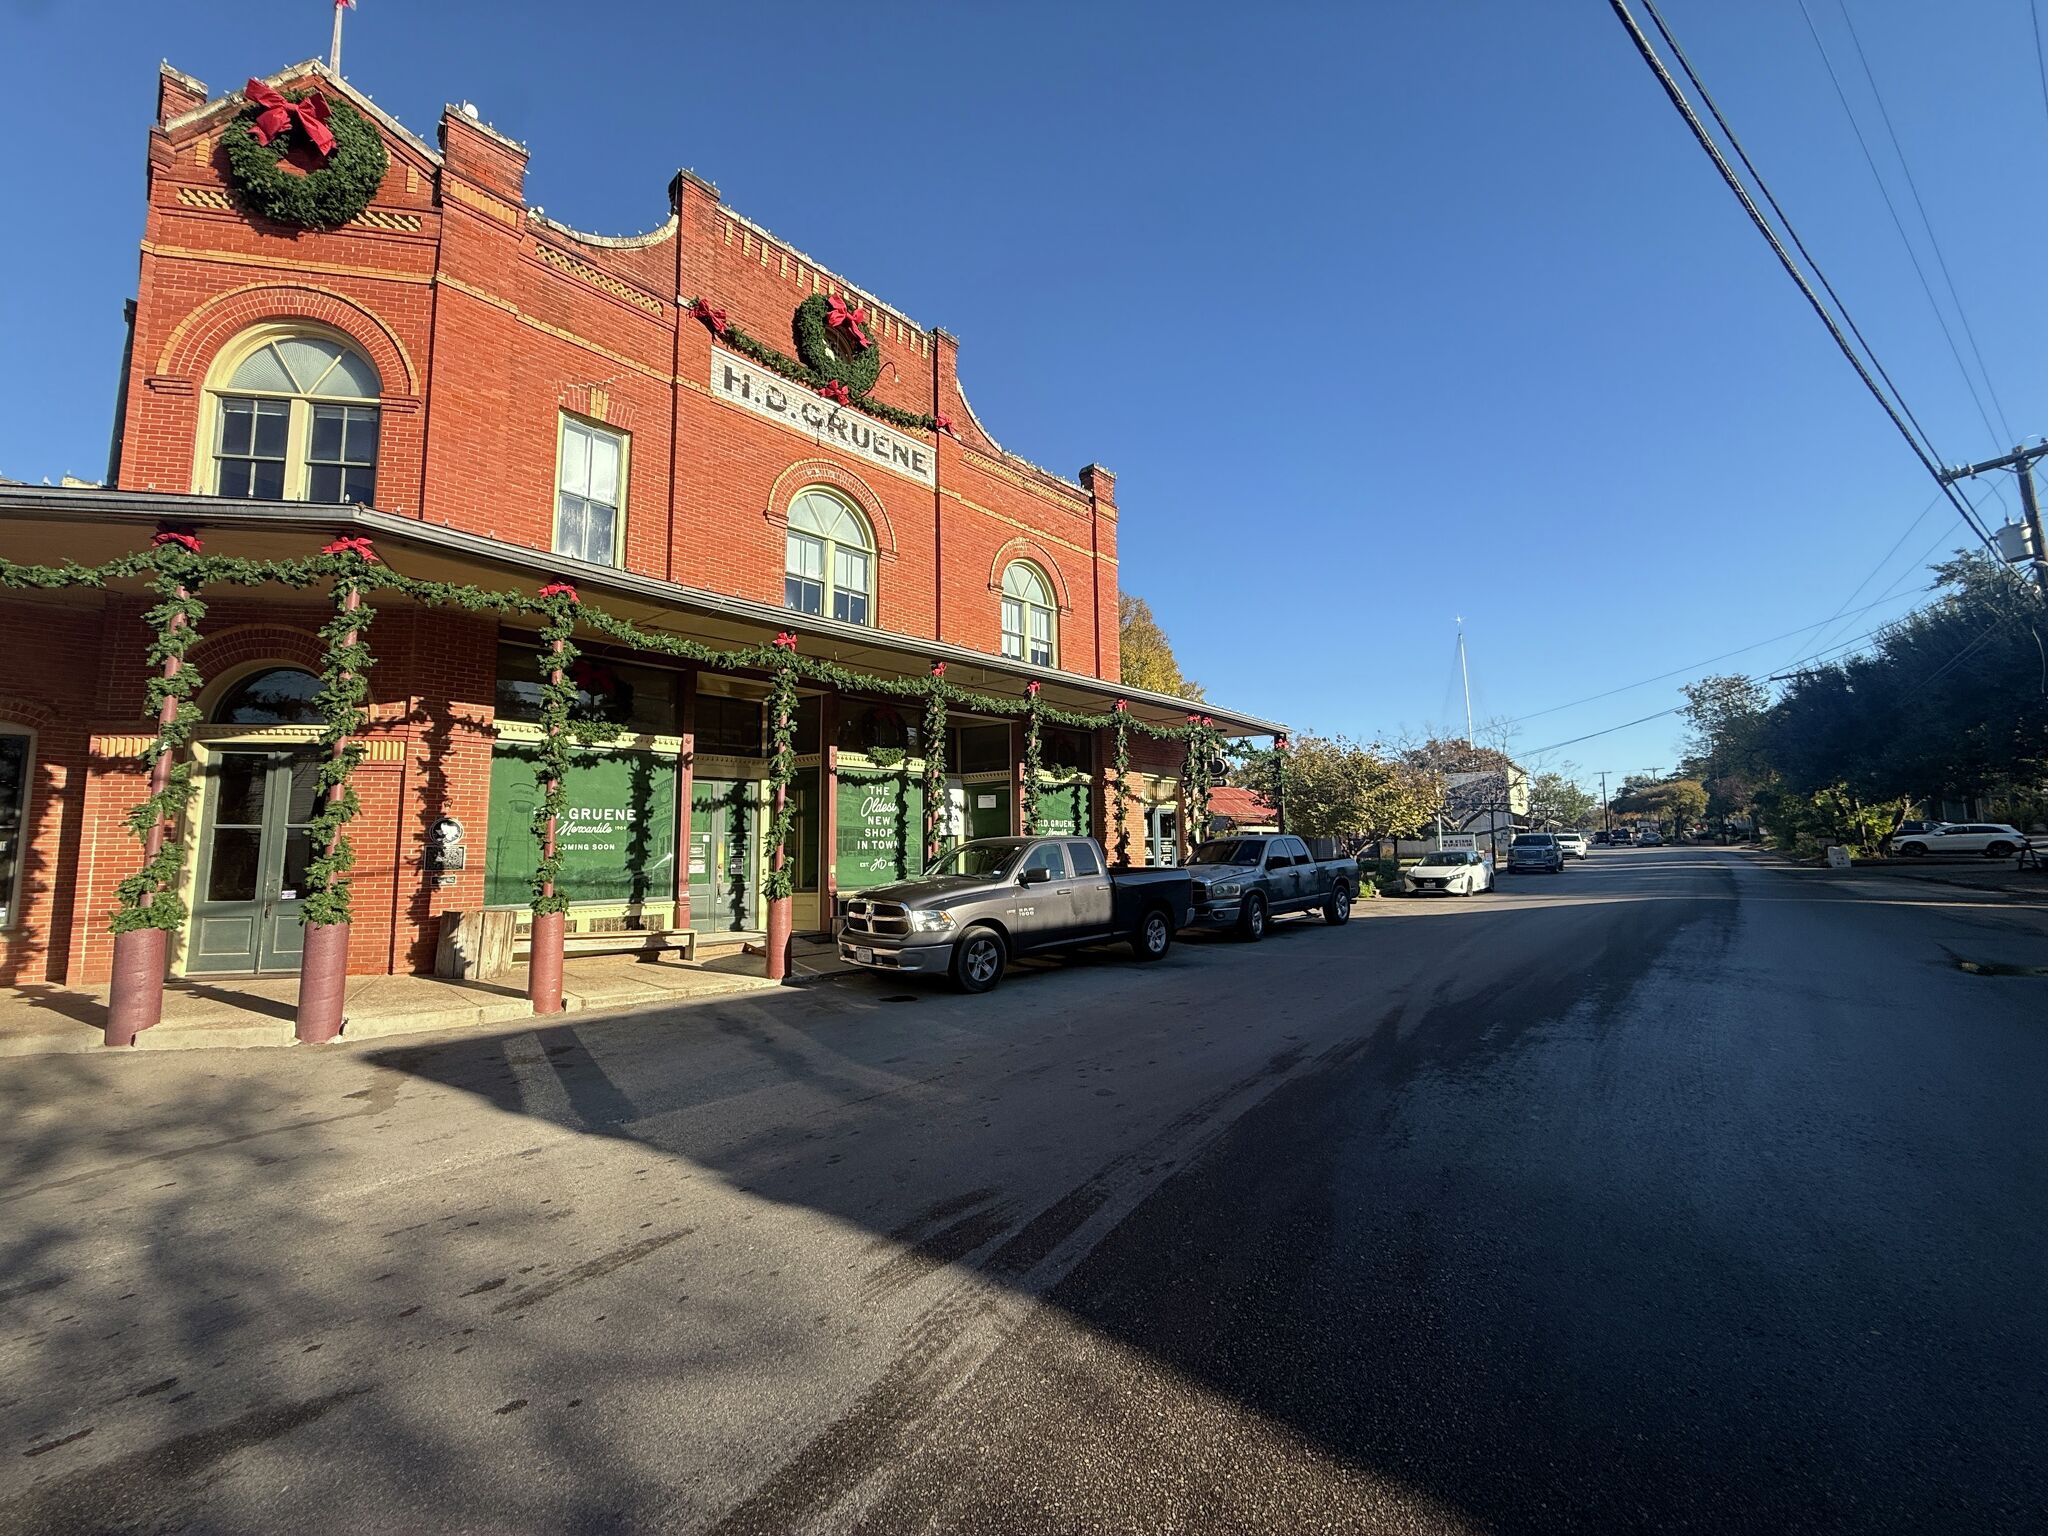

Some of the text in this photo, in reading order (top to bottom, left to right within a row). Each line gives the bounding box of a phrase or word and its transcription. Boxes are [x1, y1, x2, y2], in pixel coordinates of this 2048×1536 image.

[868, 785, 890, 796] THE
[860, 796, 898, 817] Oldest
[568, 807, 638, 821] GRUENE
[867, 815, 891, 826] NEW
[554, 820, 613, 836] Mercantile
[864, 828, 893, 838] SHOP
[592, 843, 615, 851] SOON
[856, 840, 868, 850] IN
